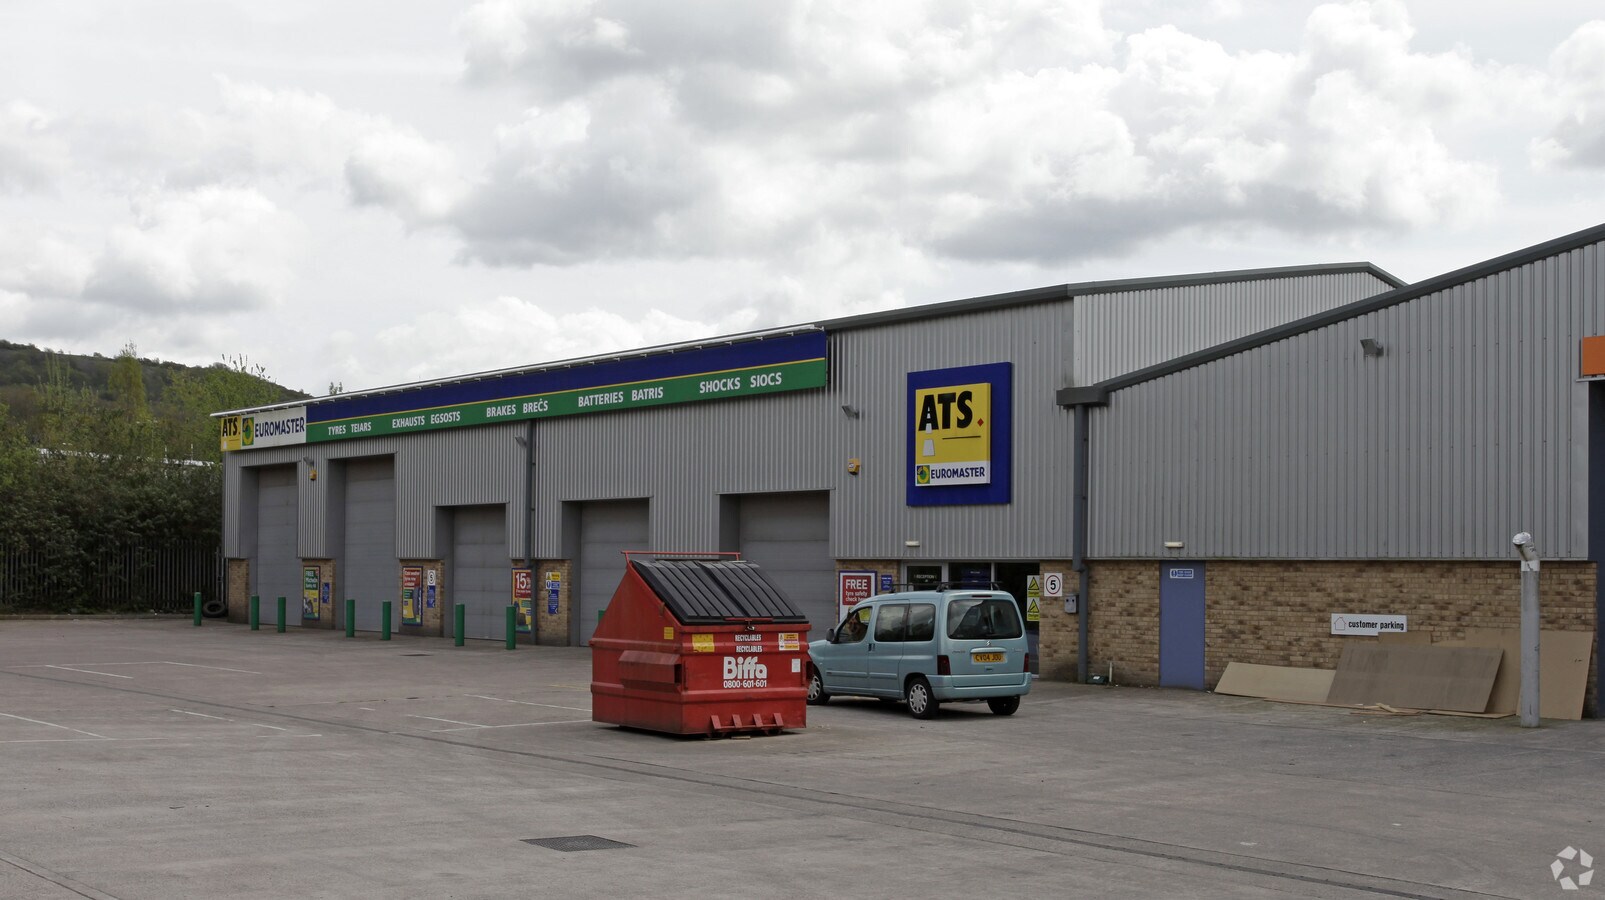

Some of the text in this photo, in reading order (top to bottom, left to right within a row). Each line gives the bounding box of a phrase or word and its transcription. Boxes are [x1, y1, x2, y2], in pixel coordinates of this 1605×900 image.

[699, 372, 783, 394] SHOCKS SIOCS
[578, 386, 664, 408] BATTERIES BATRIS
[486, 404, 516, 418] BRAKES
[918, 390, 973, 431] ATS
[254, 417, 305, 438] EUROMASTER
[392, 411, 461, 429] EXHAUSTS EGSOSTS
[328, 421, 372, 436] TYRES TEIARS
[930, 466, 985, 479] EUROMASTER
[845, 579, 868, 589] FREE
[1050, 580, 1056, 590] 5
[1348, 620, 1404, 631] customer parking
[723, 656, 768, 679] Biffa
